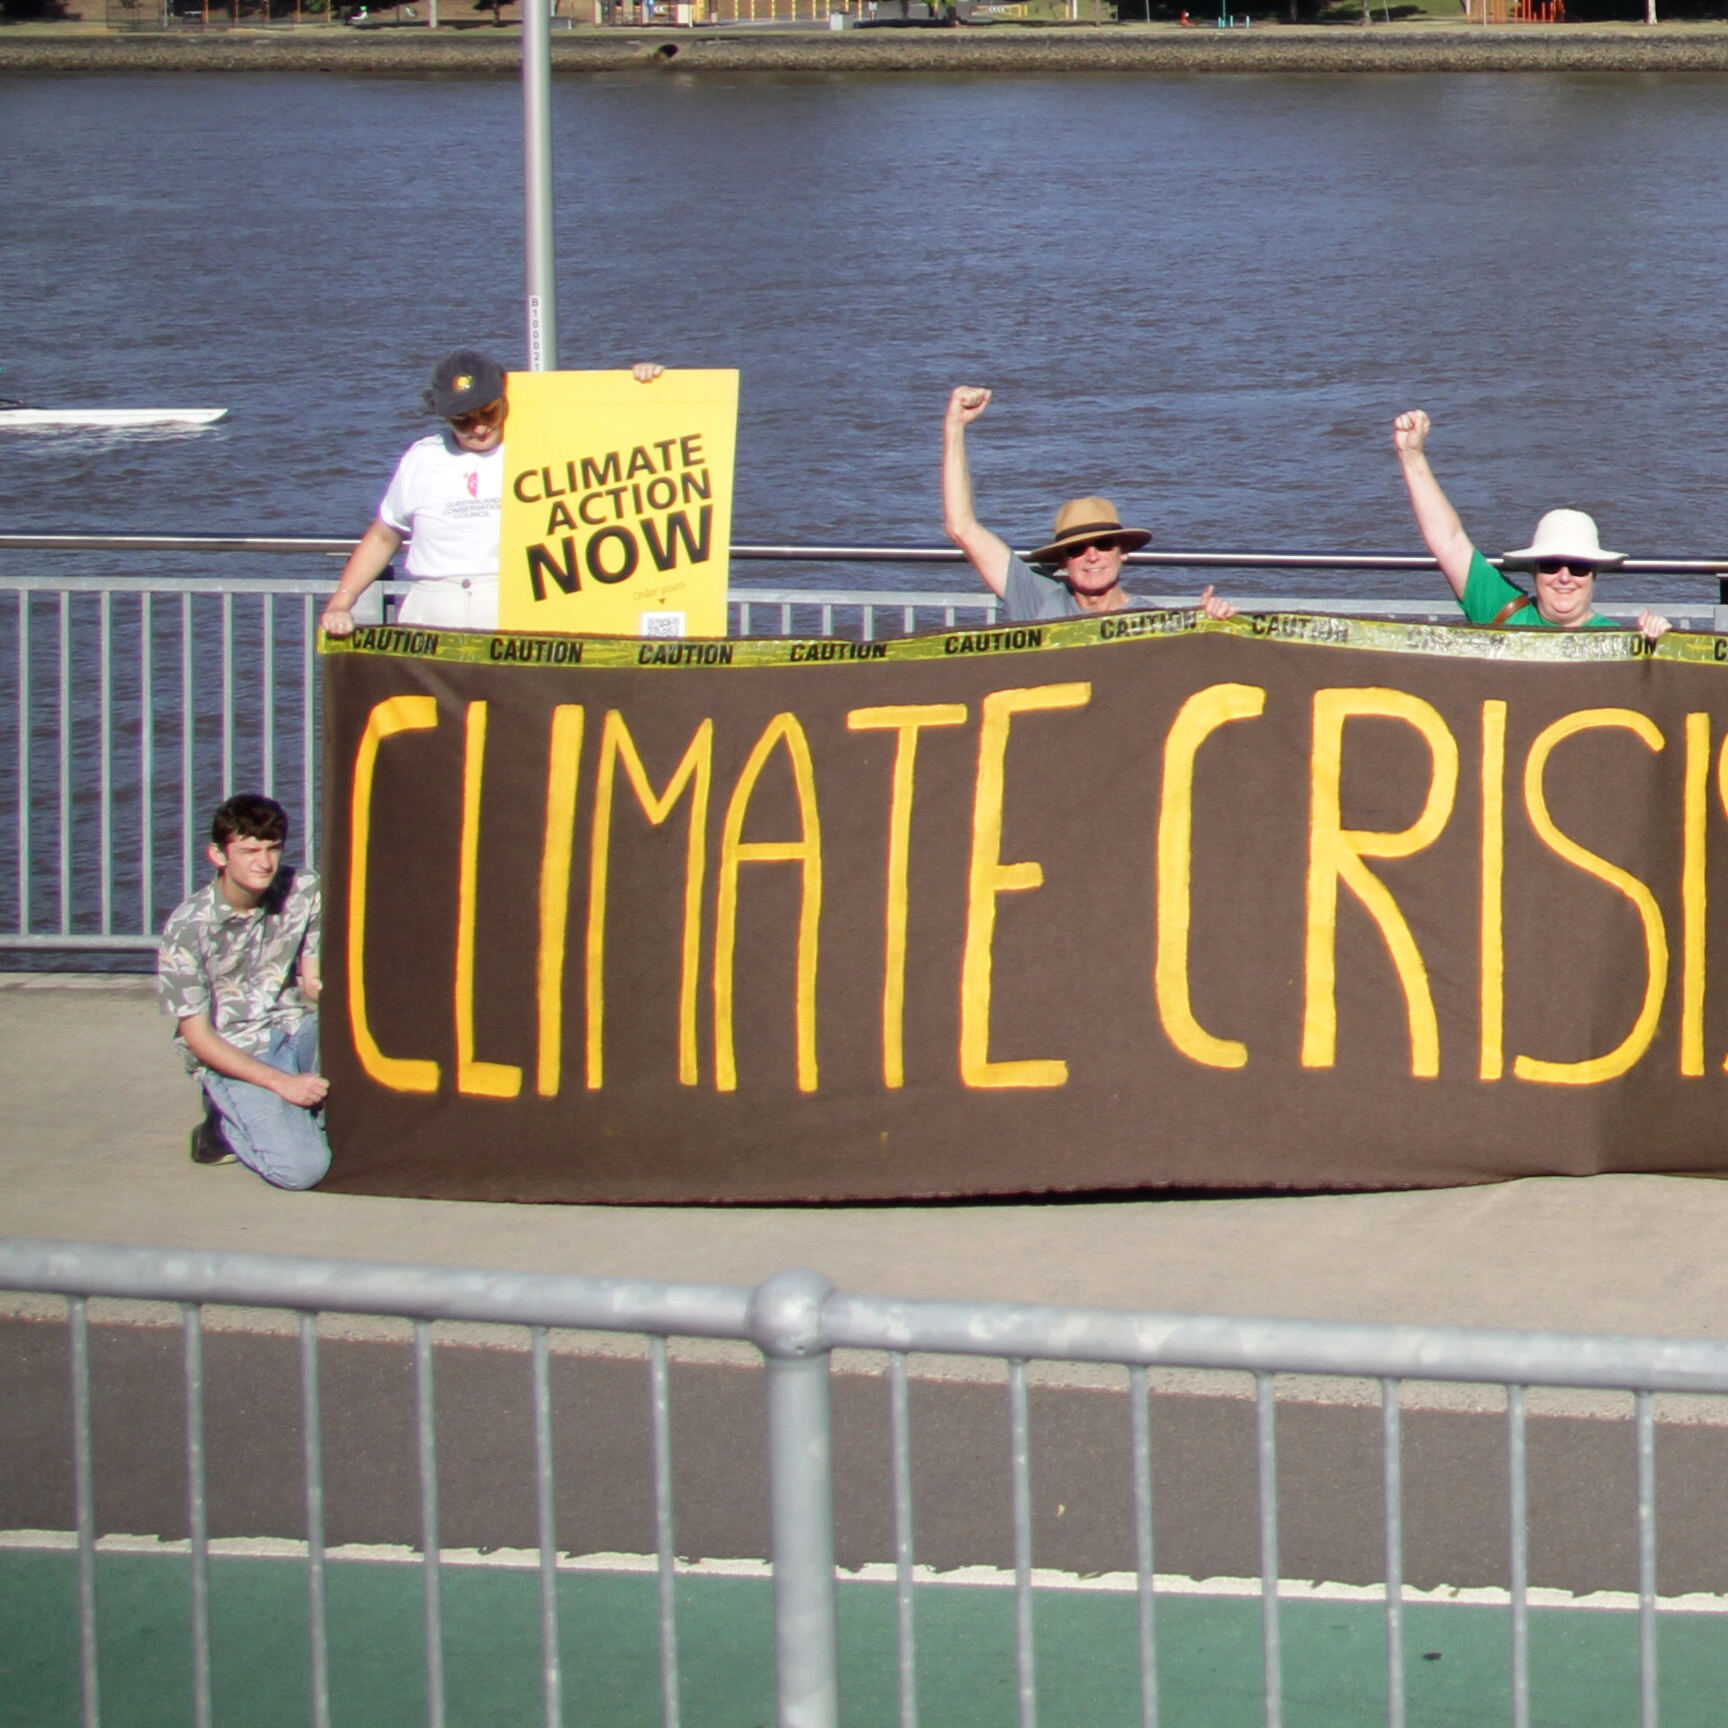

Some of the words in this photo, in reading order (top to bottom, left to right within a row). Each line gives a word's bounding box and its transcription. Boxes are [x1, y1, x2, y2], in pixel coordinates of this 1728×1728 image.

[513, 433, 705, 503] CLIMATE
[547, 468, 711, 536] ACTION
[526, 504, 713, 601] NOW
[351, 627, 439, 655] CAUTION
[490, 638, 583, 664] CAUTION
[638, 644, 733, 665] CAUTION
[790, 644, 887, 662] CAUTION
[945, 629, 1042, 654] CAUTION
[348, 682, 1093, 1098] CLIMATE
